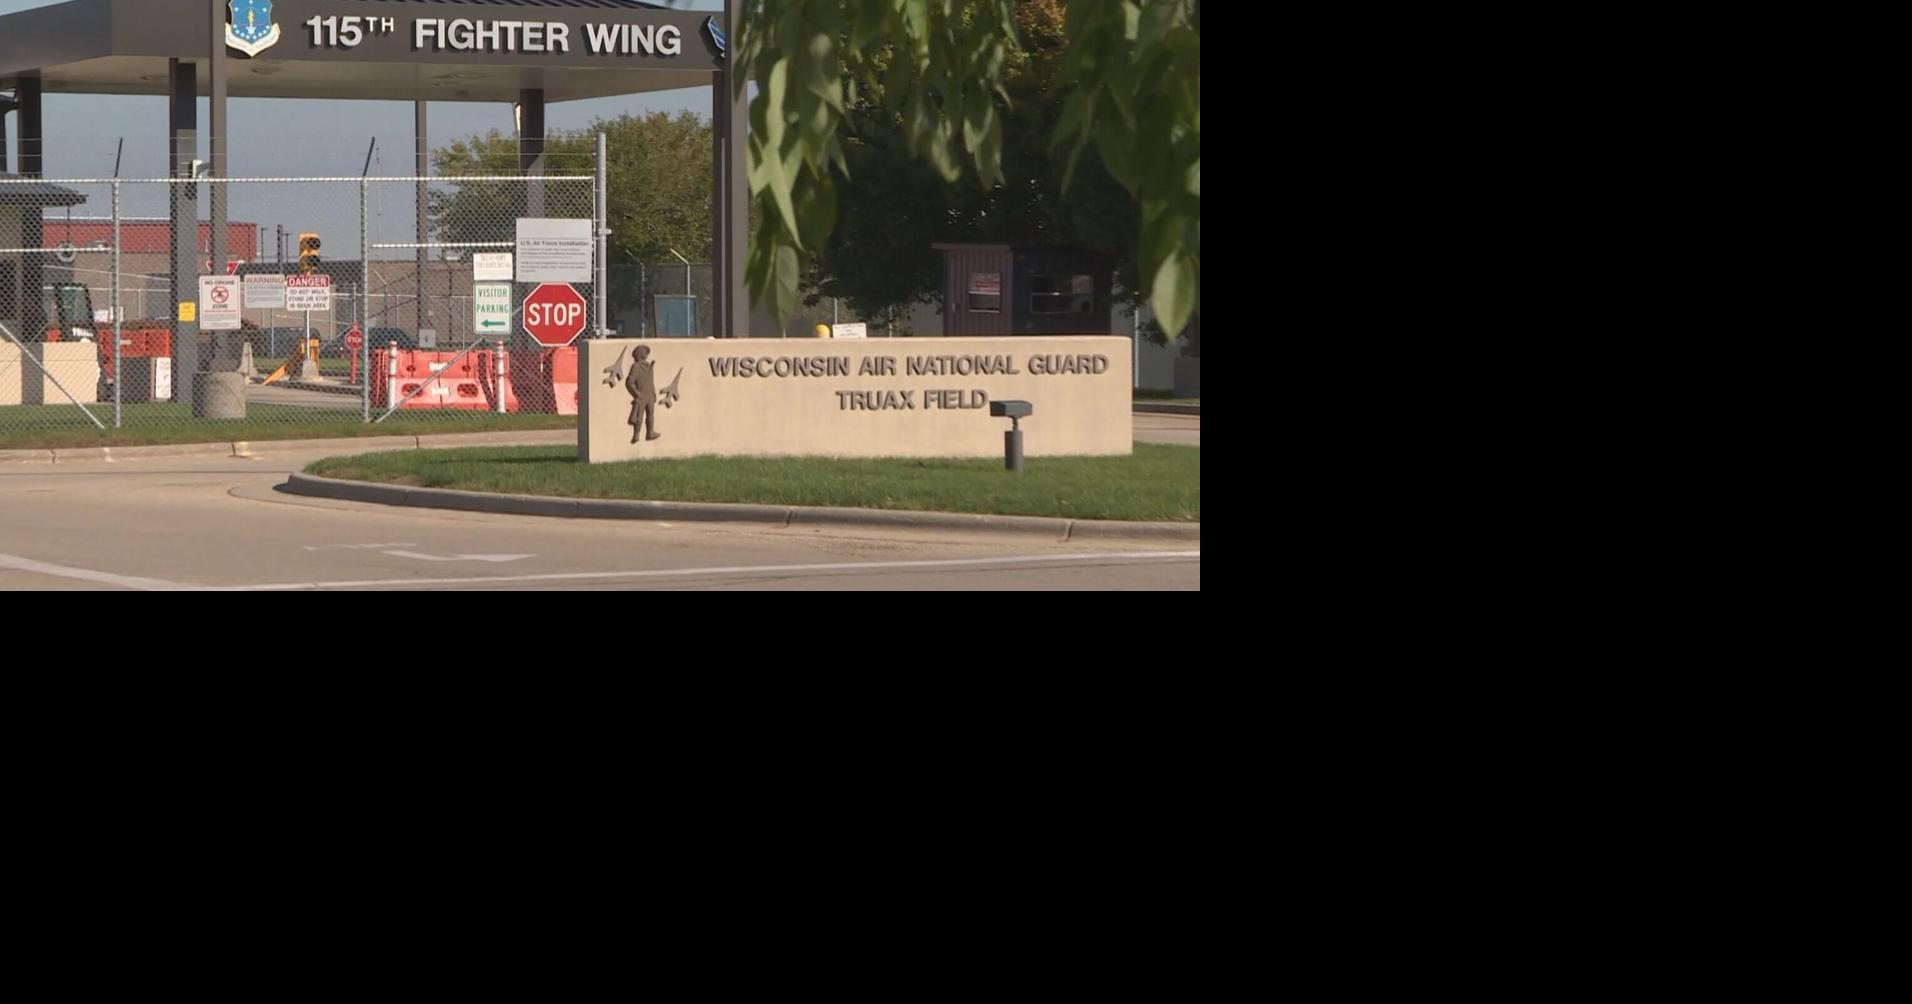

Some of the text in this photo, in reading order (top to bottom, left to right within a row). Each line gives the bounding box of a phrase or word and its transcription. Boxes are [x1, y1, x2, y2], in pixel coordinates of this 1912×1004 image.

[306, 15, 395, 47] 115TH
[415, 17, 570, 53] FIGHTER
[585, 22, 682, 56] WING
[245, 276, 284, 285] WARNING
[288, 277, 328, 287] DANGER
[478, 287, 508, 298] VISITOR
[476, 304, 509, 314] PARKING
[527, 302, 582, 327] STOP
[708, 354, 1110, 379] WISCONSIN AIR NATIONAL GUARD
[835, 388, 989, 411] TRUAX FIELD
